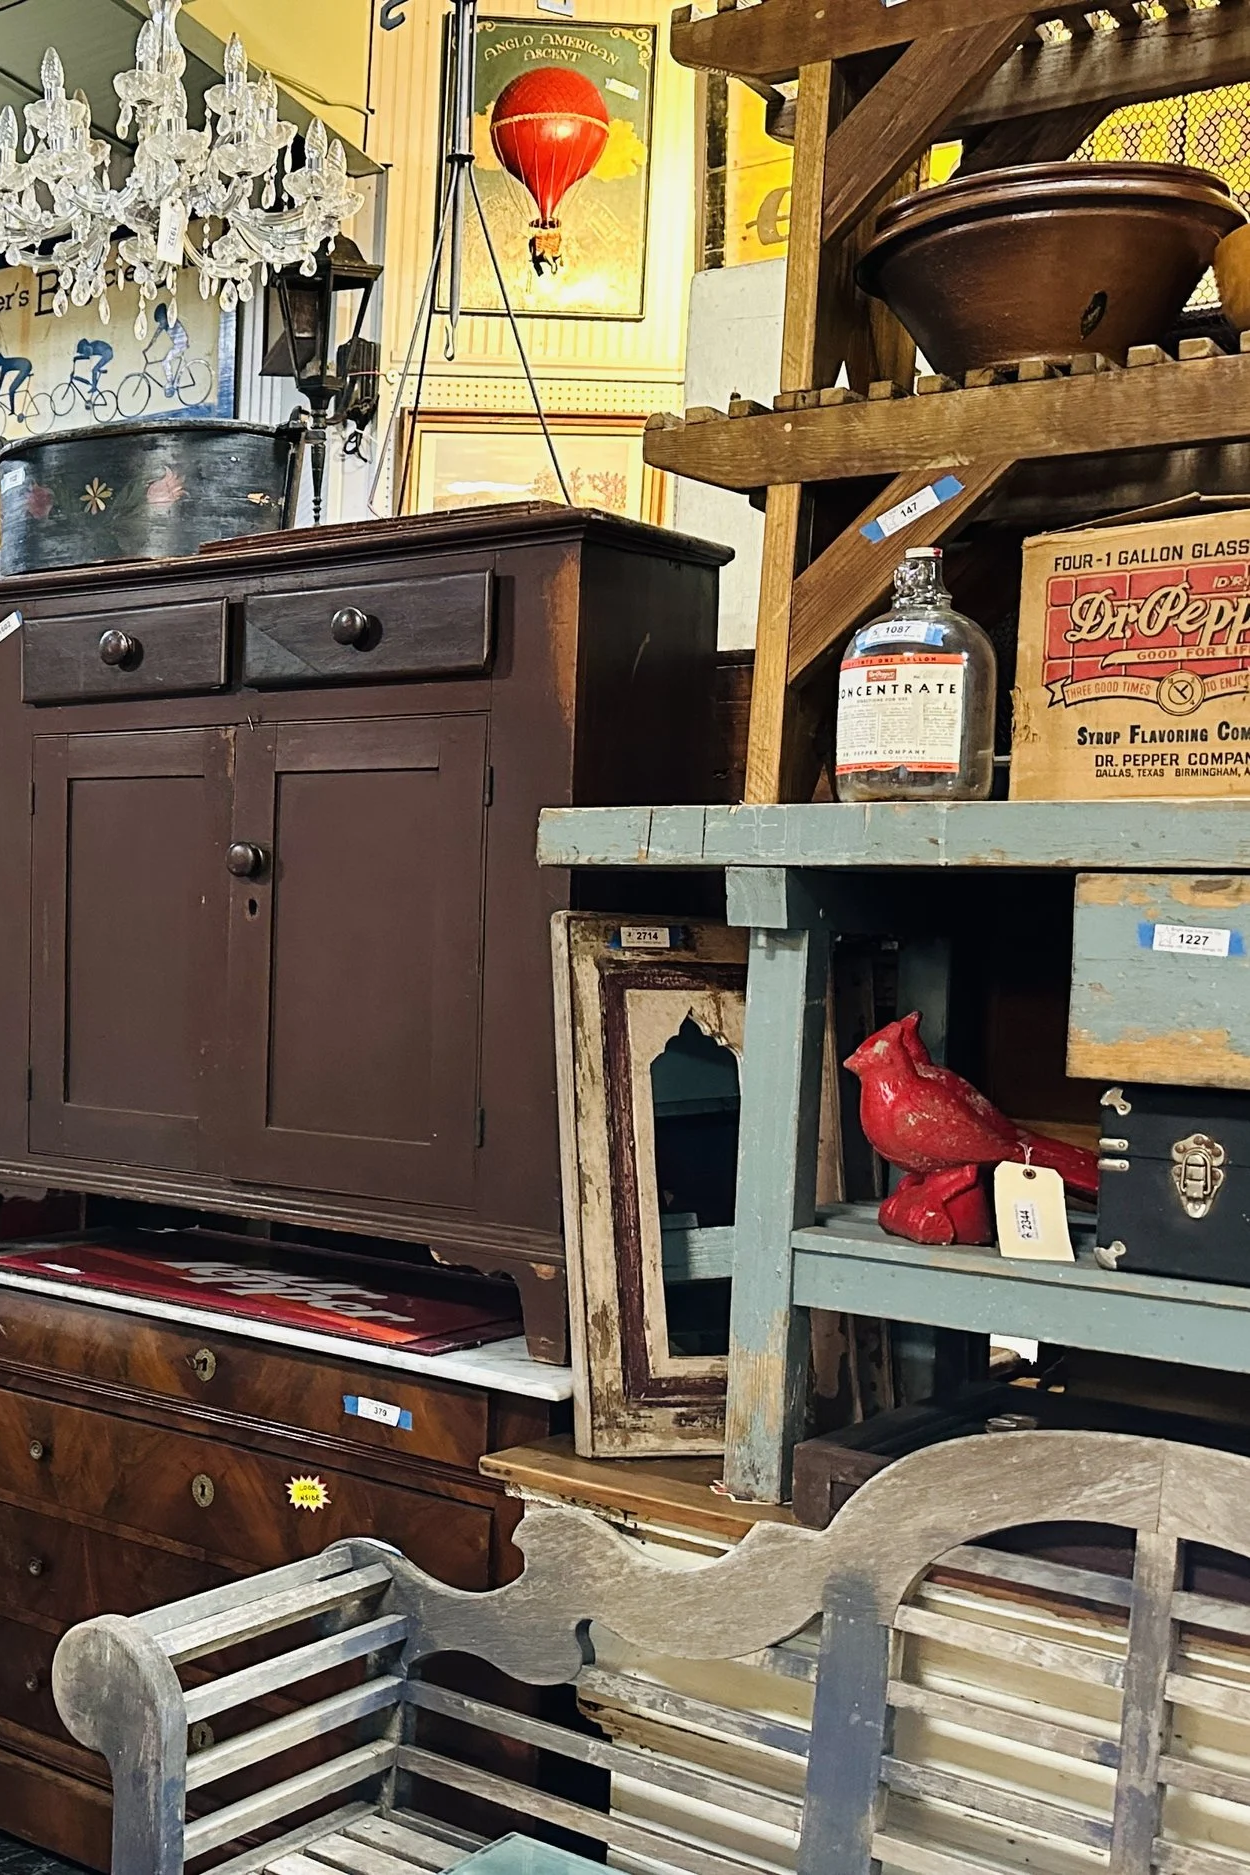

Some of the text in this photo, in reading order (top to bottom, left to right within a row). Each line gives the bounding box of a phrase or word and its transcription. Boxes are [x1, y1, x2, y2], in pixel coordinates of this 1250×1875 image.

[484, 33, 620, 66] ANGLO AMERICAN
[524, 48, 581, 63] ASCENT
[900, 501, 918, 518] 147
[1118, 545, 1184, 566] GALLON
[1192, 538, 1250, 560] GLASS
[885, 625, 911, 634] 1087
[1137, 645, 1250, 661] GOOD FOR LIF
[838, 683, 957, 700] ONCENTRATE
[1066, 684, 1093, 701] THREE
[1094, 681, 1119, 697] GOOD
[1122, 681, 1151, 697] TIMES
[1205, 680, 1217, 693] TO
[1077, 726, 1121, 746] SYRUP
[1130, 724, 1209, 744] FLAVORING
[1095, 754, 1119, 768] DR.
[1122, 752, 1180, 767] PEPPER
[1095, 768, 1135, 779] DALLAS,
[1137, 768, 1165, 778] TEXAS
[1175, 766, 1241, 778] BIRMINGHAM,
[636, 931, 659, 941] 2714
[1179, 933, 1209, 946] 1227
[1019, 1210, 1033, 1230] 2344
[373, 1406, 388, 1418] 379
